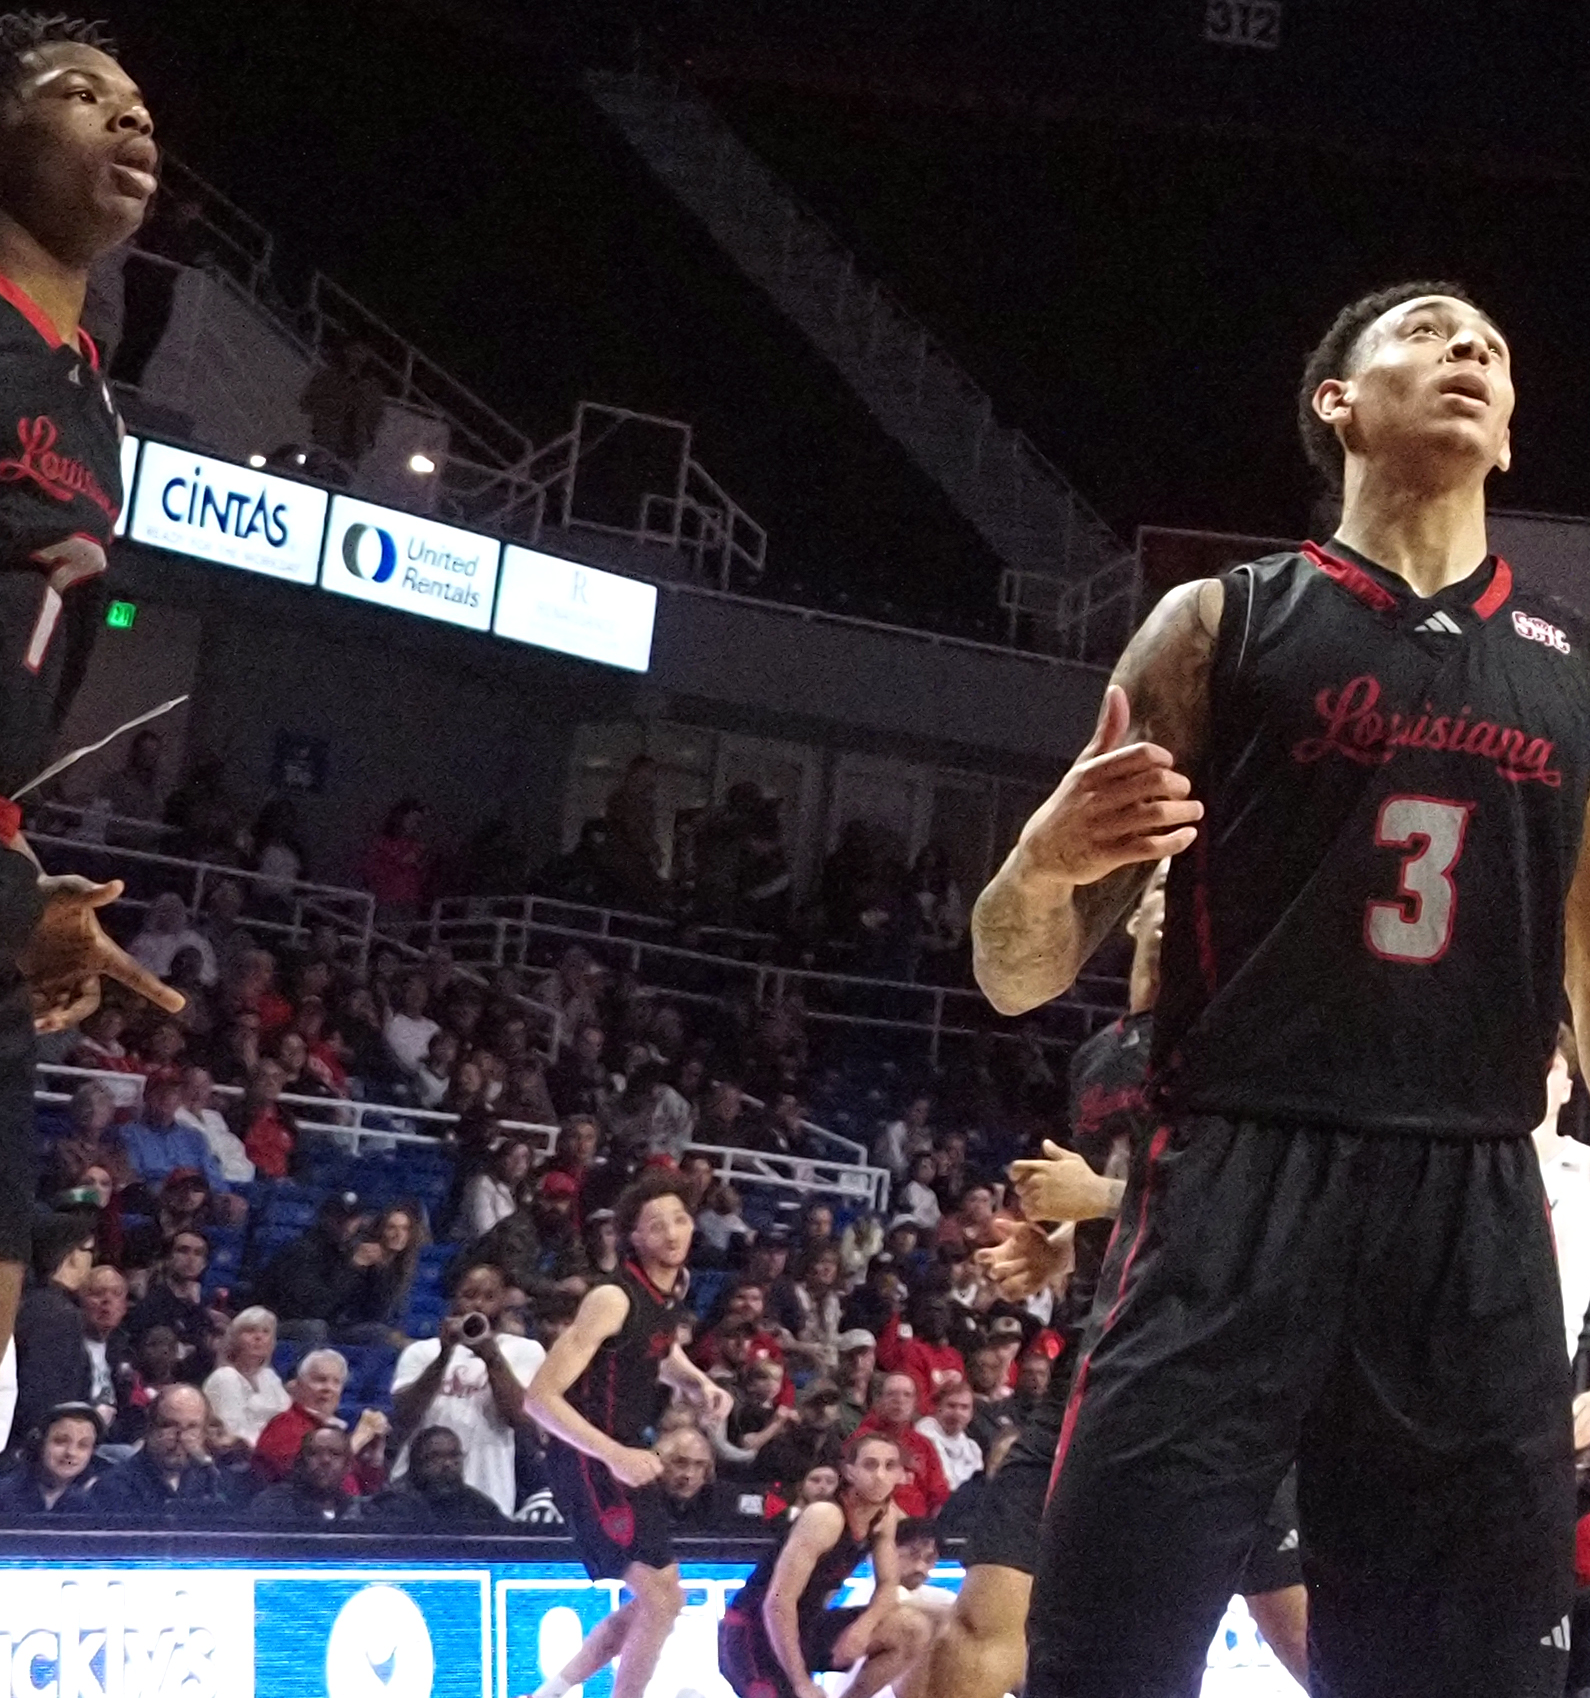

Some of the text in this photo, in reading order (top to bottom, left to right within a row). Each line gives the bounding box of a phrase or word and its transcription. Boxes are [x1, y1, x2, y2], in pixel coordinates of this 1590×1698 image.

[1210, 0, 1277, 43] 312
[407, 537, 481, 577] United
[402, 566, 481, 608] Rentals
[1292, 674, 1561, 788] Louisiana
[1363, 794, 1475, 964] 3
